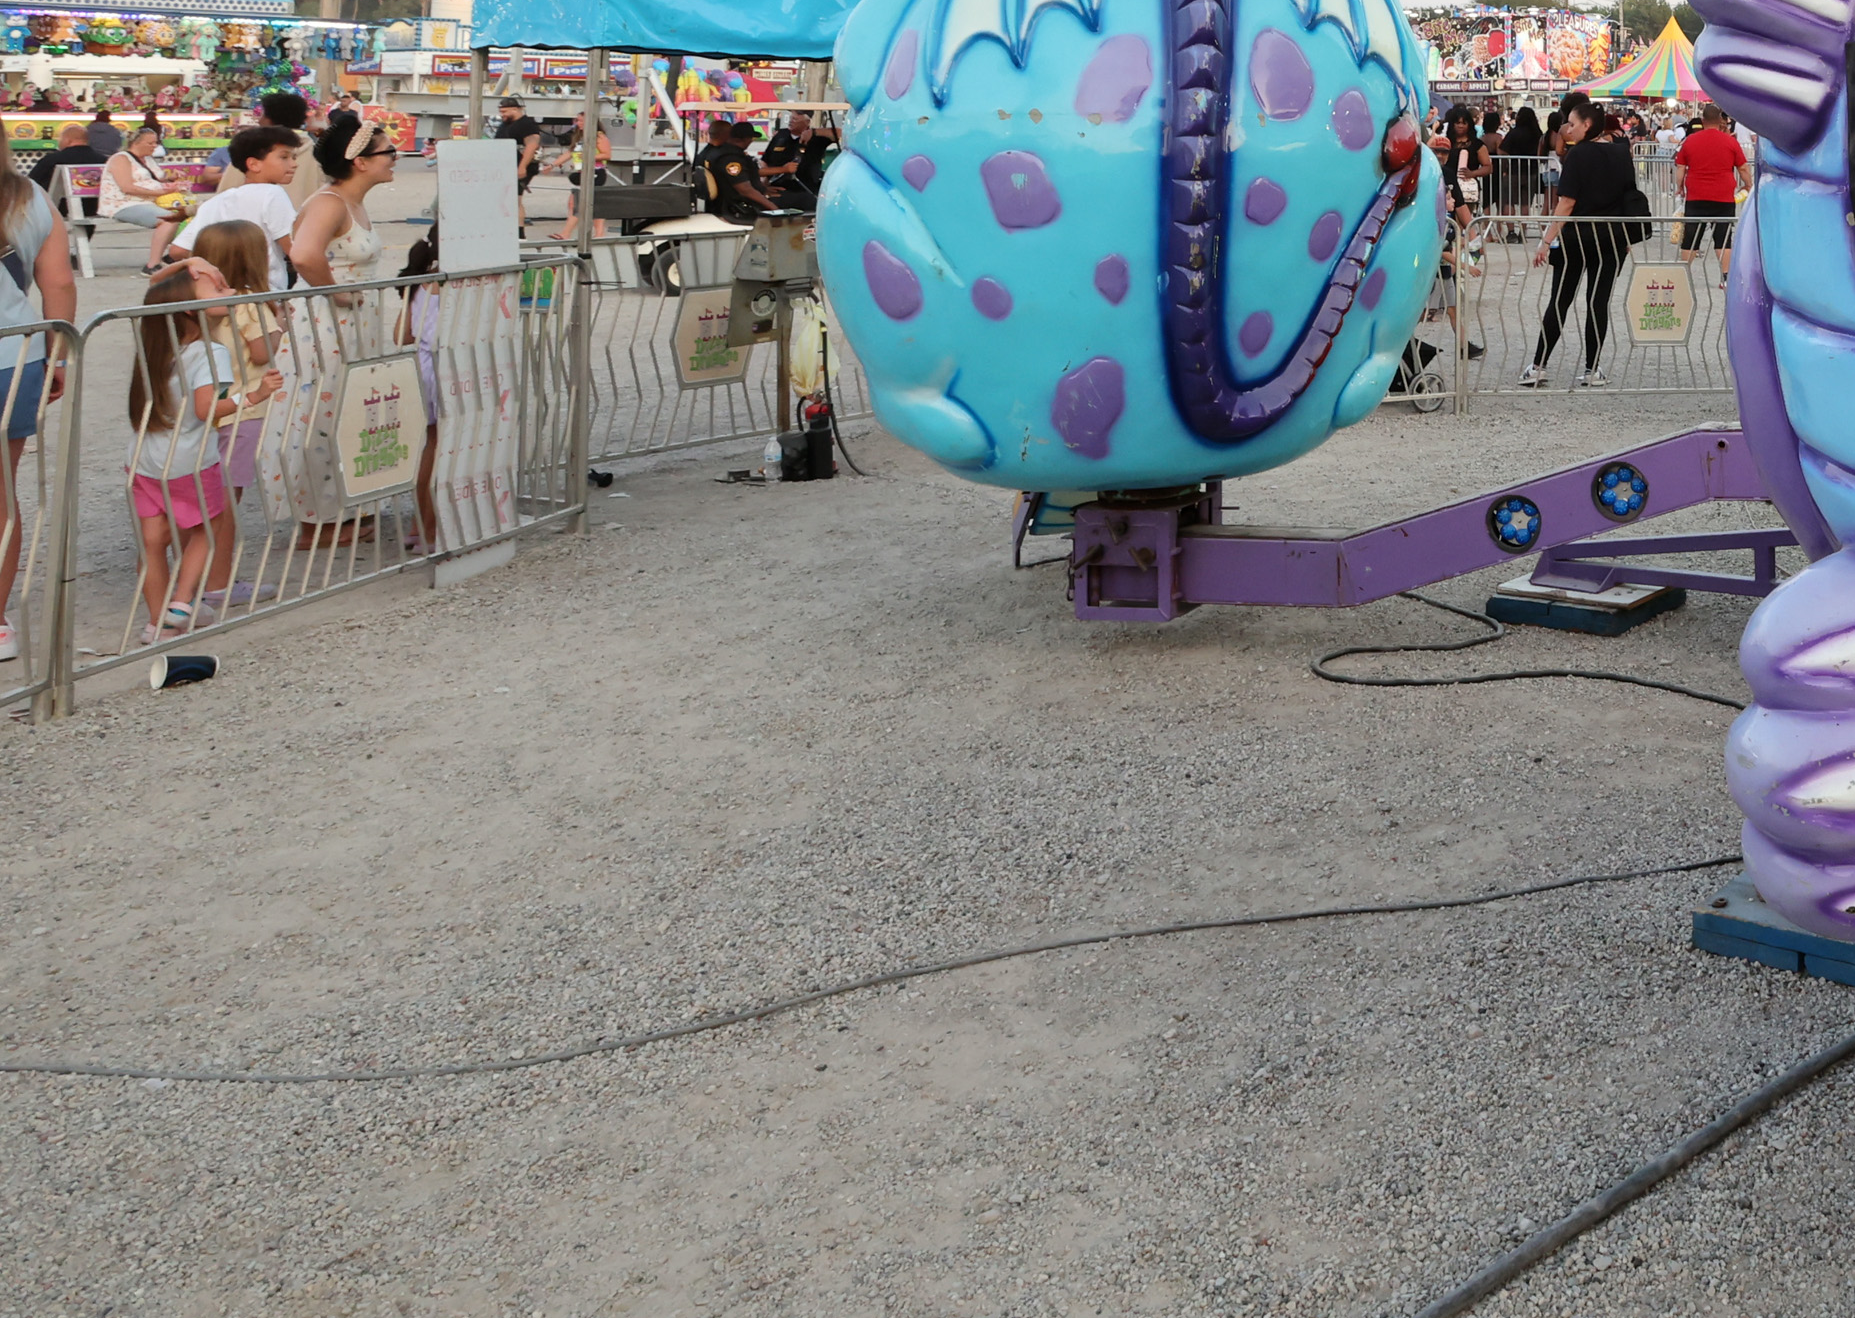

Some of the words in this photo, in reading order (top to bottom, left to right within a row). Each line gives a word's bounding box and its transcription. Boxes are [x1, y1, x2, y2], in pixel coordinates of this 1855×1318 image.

[1436, 82, 1460, 90] CARAMEL
[1643, 302, 1673, 319] Dizzy
[1639, 315, 1681, 330] Dragons
